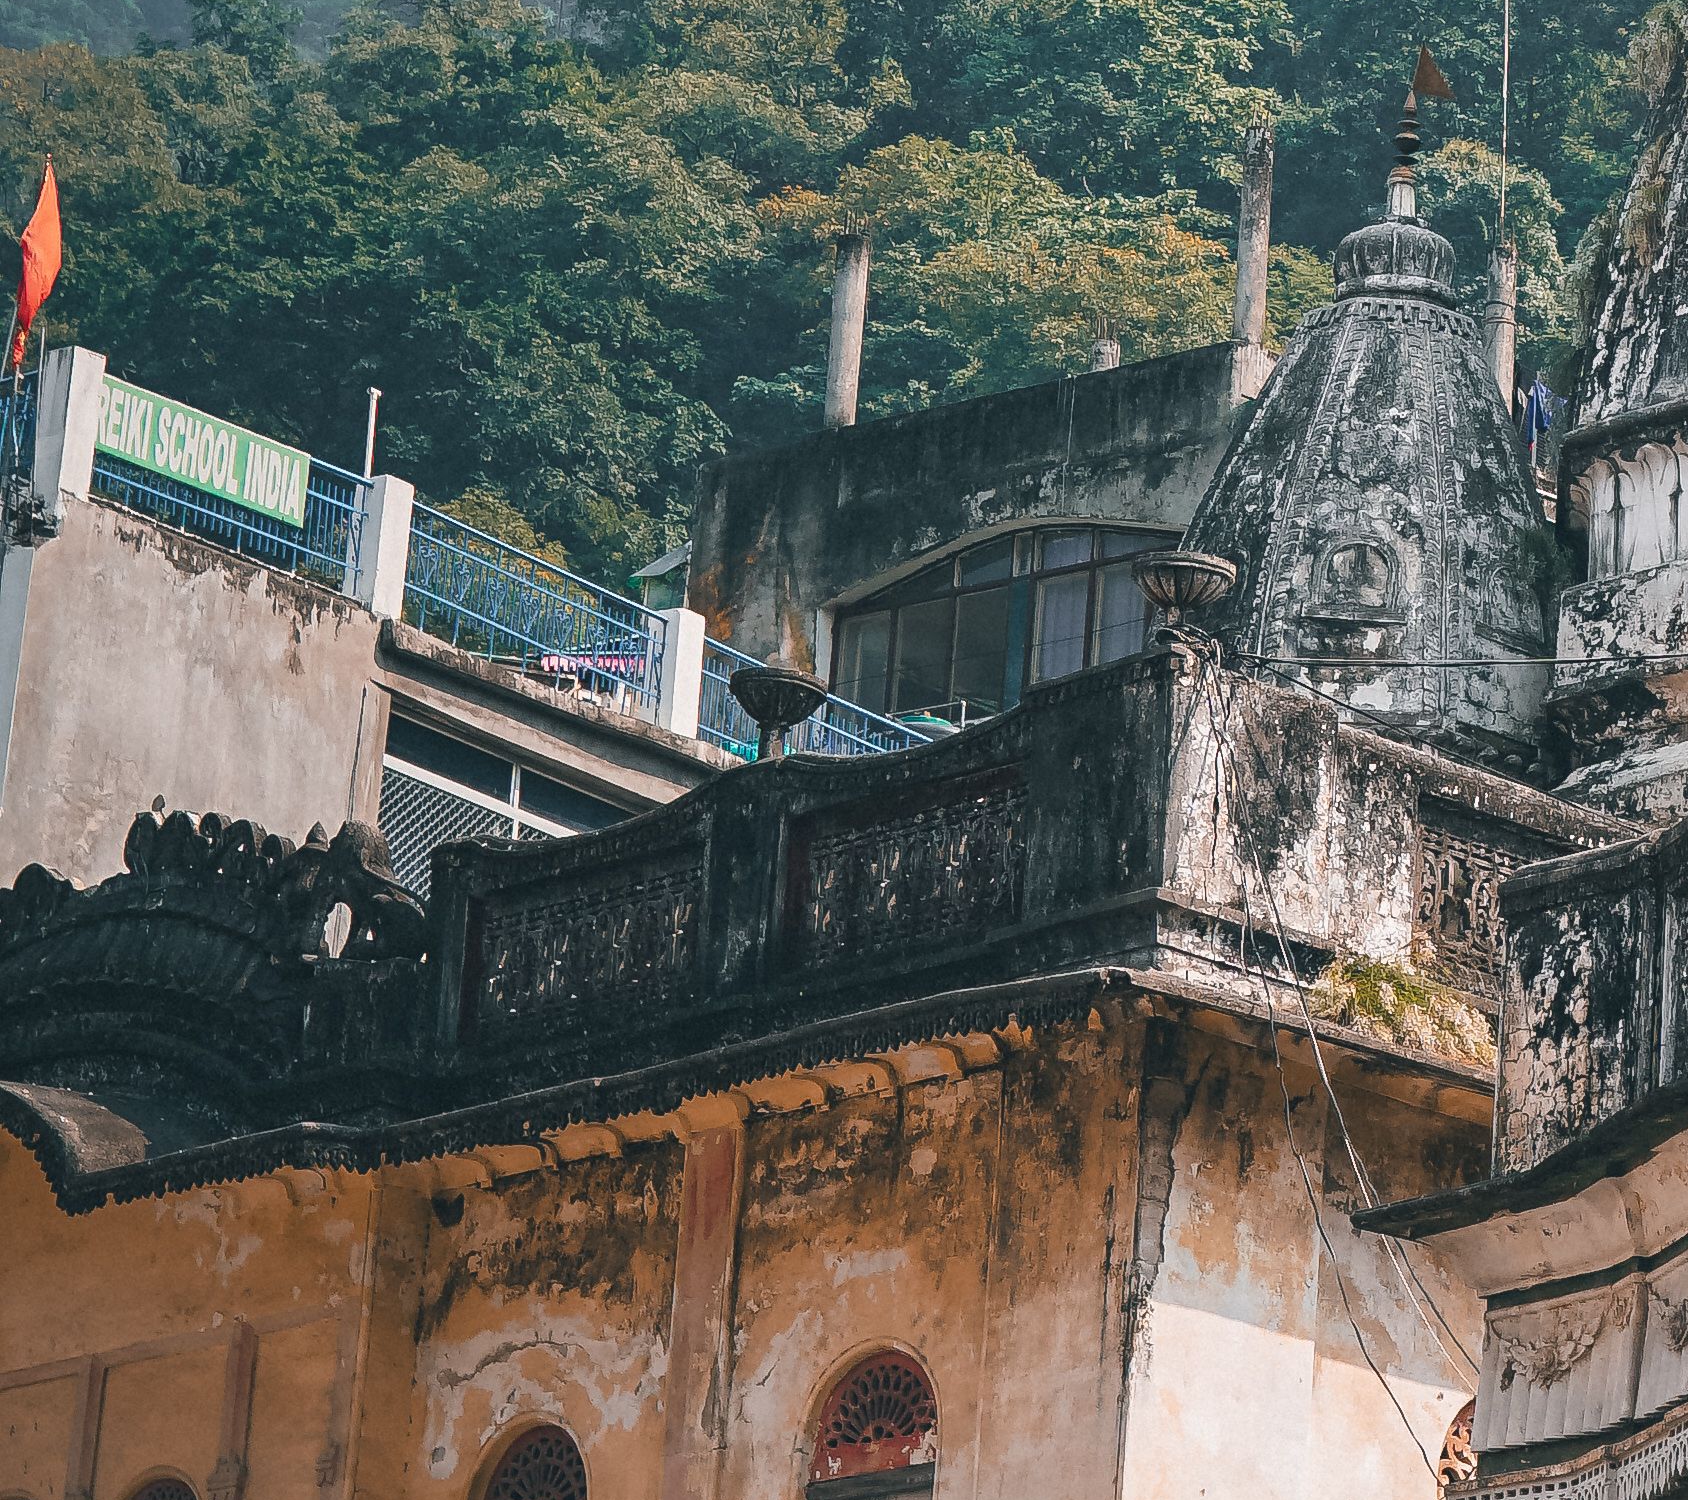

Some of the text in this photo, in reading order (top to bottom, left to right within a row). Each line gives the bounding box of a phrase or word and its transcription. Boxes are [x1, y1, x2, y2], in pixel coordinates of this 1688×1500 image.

[97, 384, 301, 519] REIKI SCHOOL INDIA
